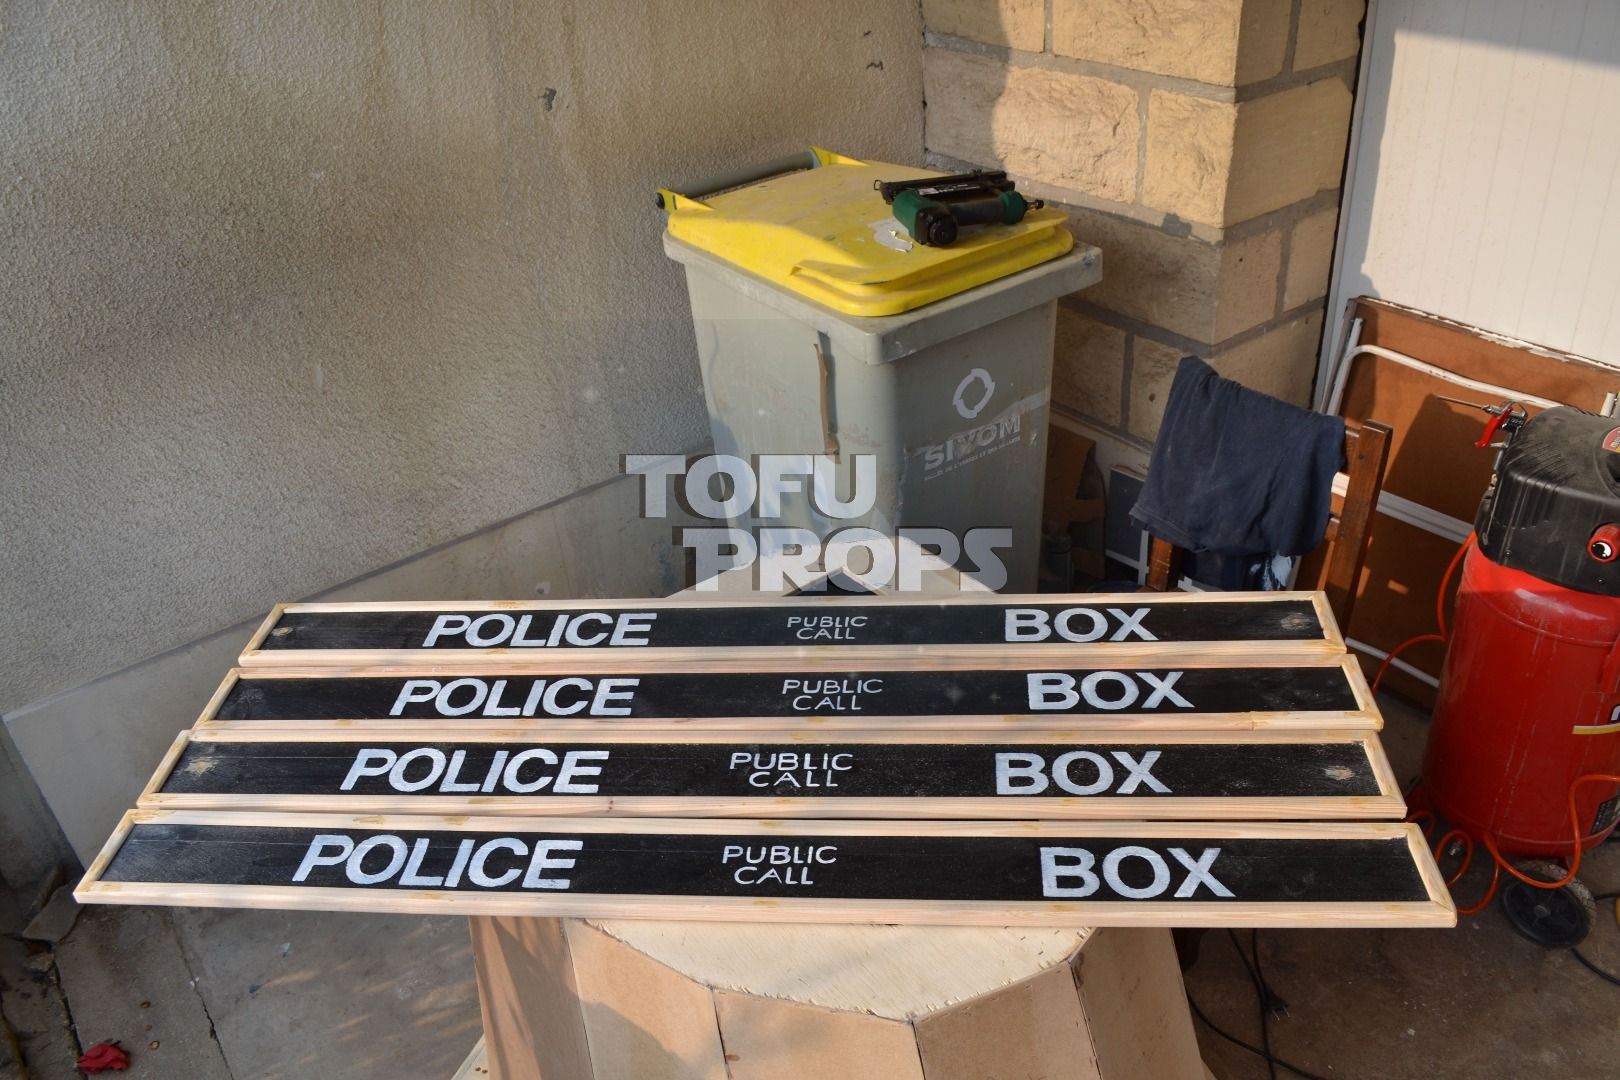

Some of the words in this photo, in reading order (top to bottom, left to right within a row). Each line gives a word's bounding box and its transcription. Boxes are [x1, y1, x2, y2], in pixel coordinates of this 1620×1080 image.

[423, 613, 657, 647] POLICE
[787, 616, 868, 628] PUBLIC
[796, 628, 856, 640] CALL
[1004, 608, 1159, 643] BOX
[389, 677, 640, 717] POLICE
[782, 679, 884, 694] PUBLIC
[1027, 671, 1195, 710] BOX
[792, 695, 862, 711] CALL
[340, 748, 610, 793] POLICE
[729, 753, 854, 771] PUBLIC
[995, 751, 1173, 795] BOX
[749, 770, 839, 788] CALL
[292, 834, 583, 889] POLICE
[722, 845, 838, 864] PUBLIC
[733, 866, 814, 885] CALL
[1040, 846, 1237, 899] BOX
